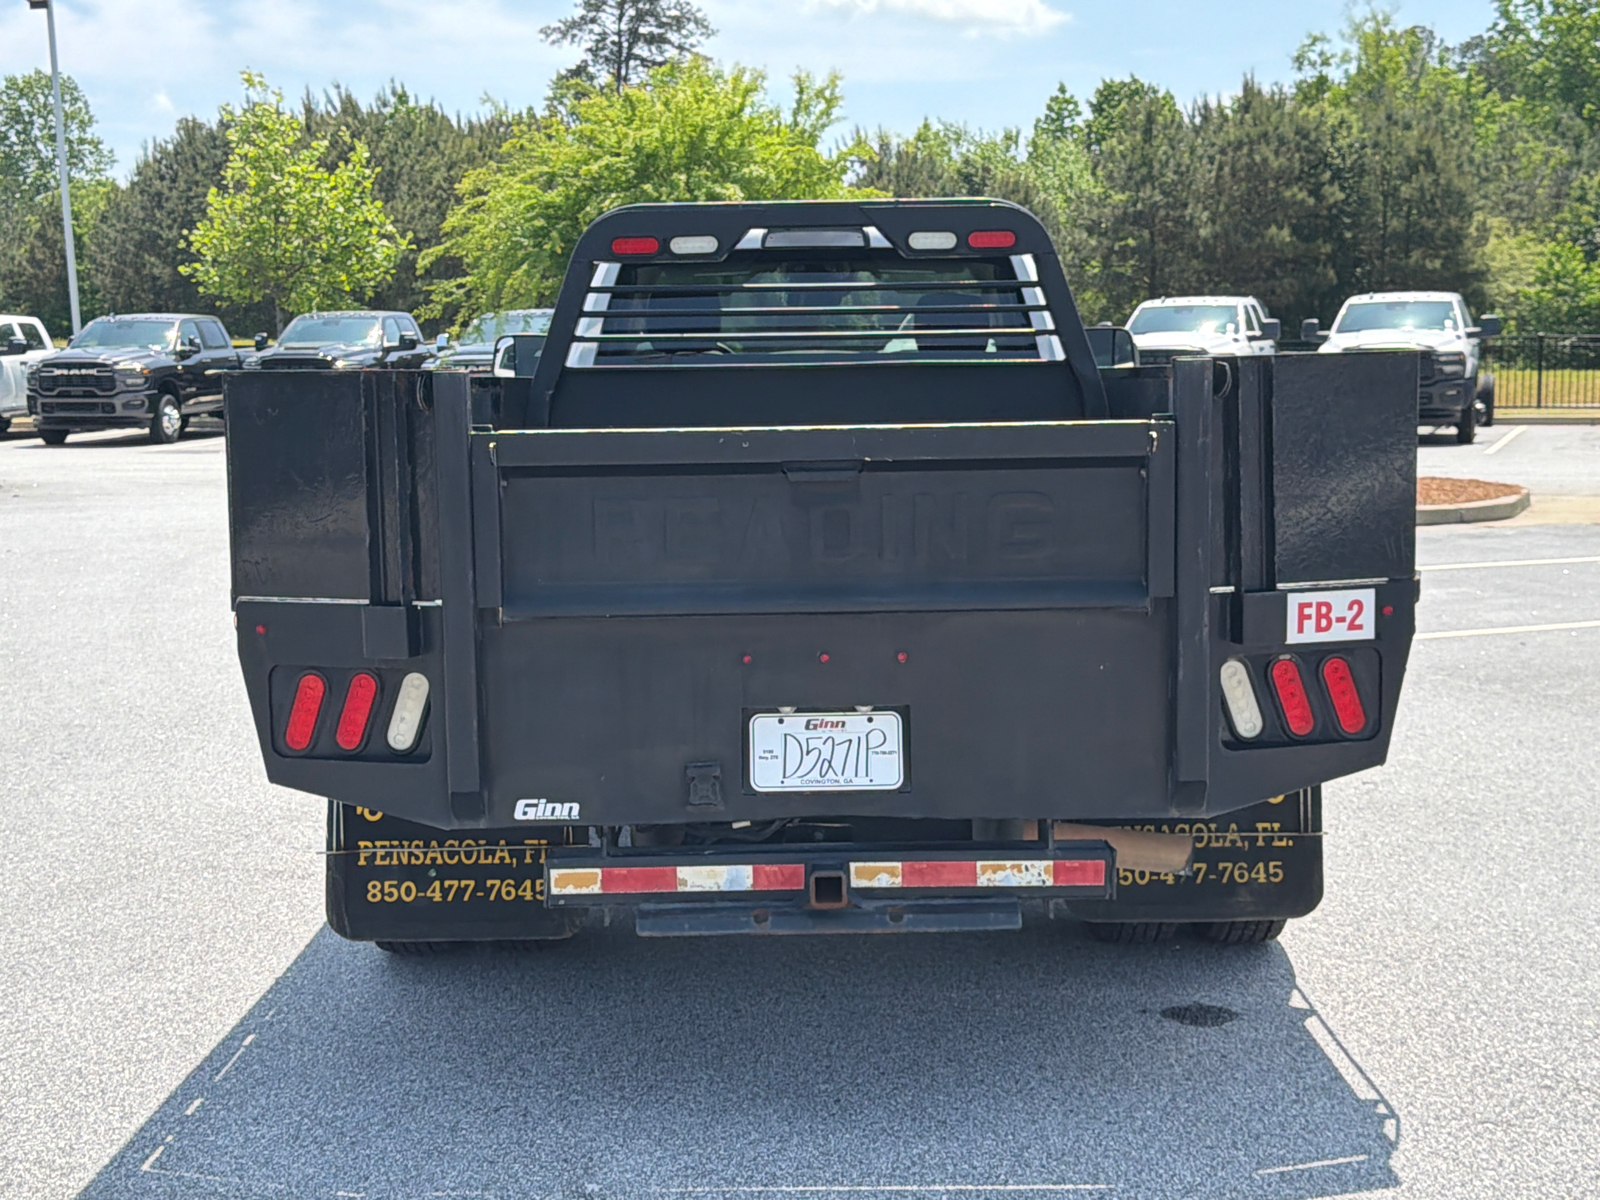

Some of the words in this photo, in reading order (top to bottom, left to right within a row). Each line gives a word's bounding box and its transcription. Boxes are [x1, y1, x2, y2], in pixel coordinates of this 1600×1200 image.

[56, 368, 95, 376] RAM
[591, 489, 1056, 565] READING
[1297, 598, 1364, 634] FB-2
[804, 718, 846, 731] Ginn
[513, 798, 580, 820] Ginn
[1255, 822, 1294, 847] FL.
[357, 839, 517, 868] PENSACOLA,
[1118, 861, 1285, 886] 50-47-7645
[366, 878, 545, 903] 850-477-7645
